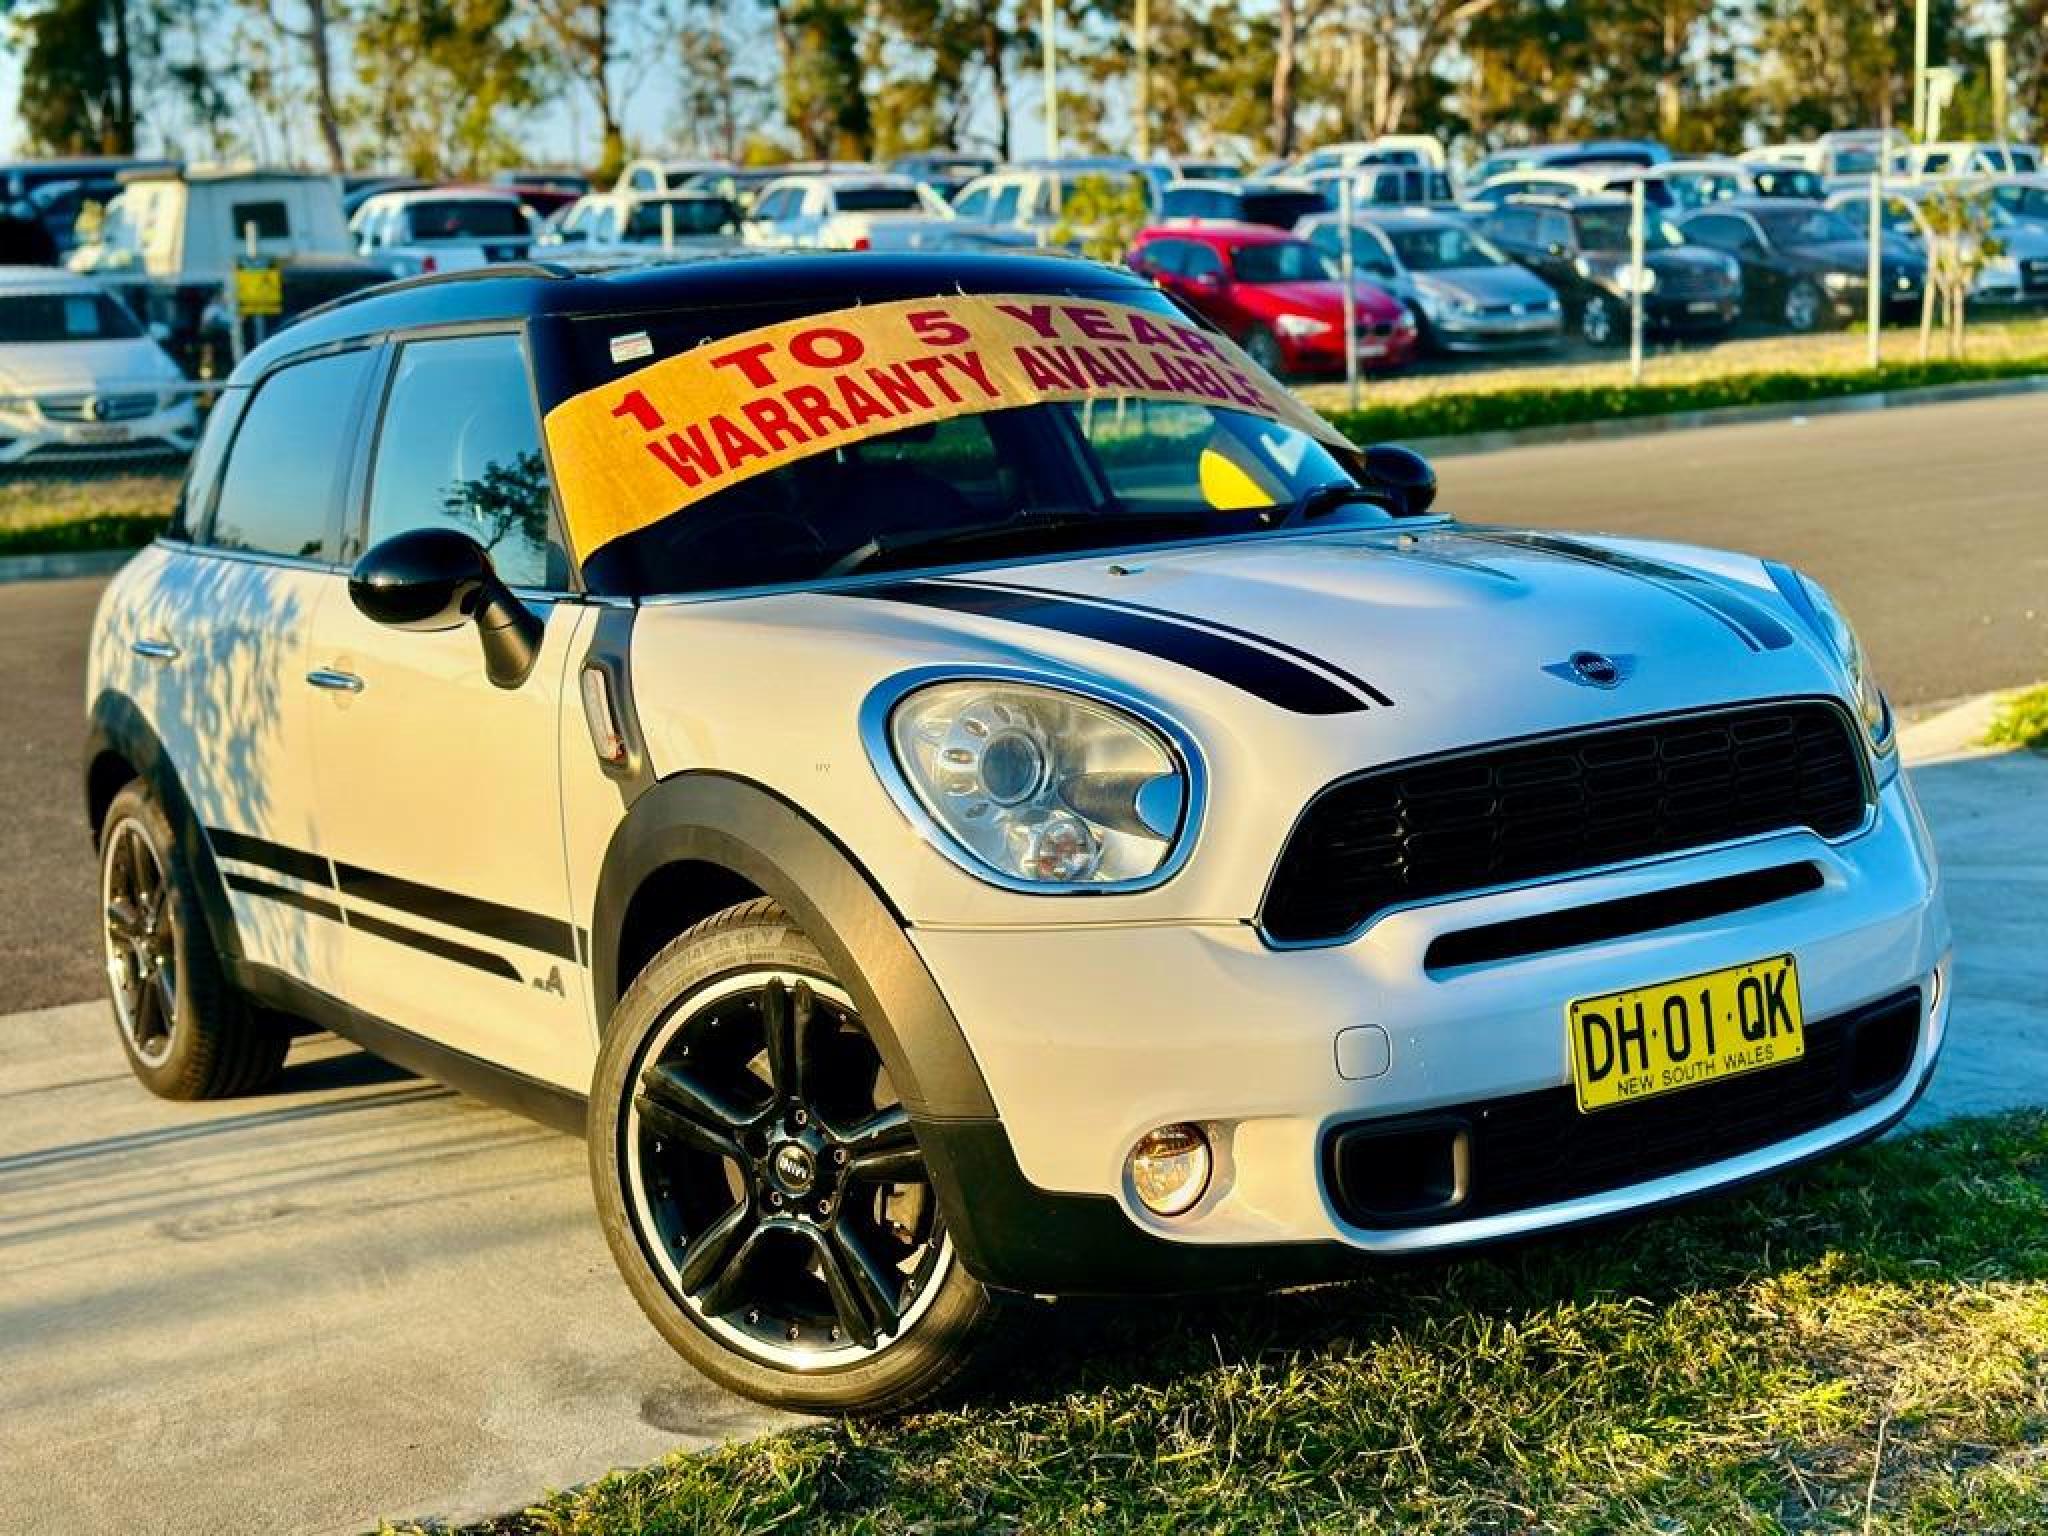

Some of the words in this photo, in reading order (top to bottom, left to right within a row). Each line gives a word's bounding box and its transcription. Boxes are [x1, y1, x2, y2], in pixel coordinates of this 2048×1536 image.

[611, 389, 665, 433] 1
[709, 327, 865, 389] TO
[905, 310, 971, 347] 5
[644, 350, 1002, 489] WARRANTY
[1012, 345, 1281, 415] AVAILABLE
[1616, 1073, 1656, 1097] NEW
[1661, 1058, 1717, 1087] SOUTH
[1722, 1043, 1775, 1071] WALES
